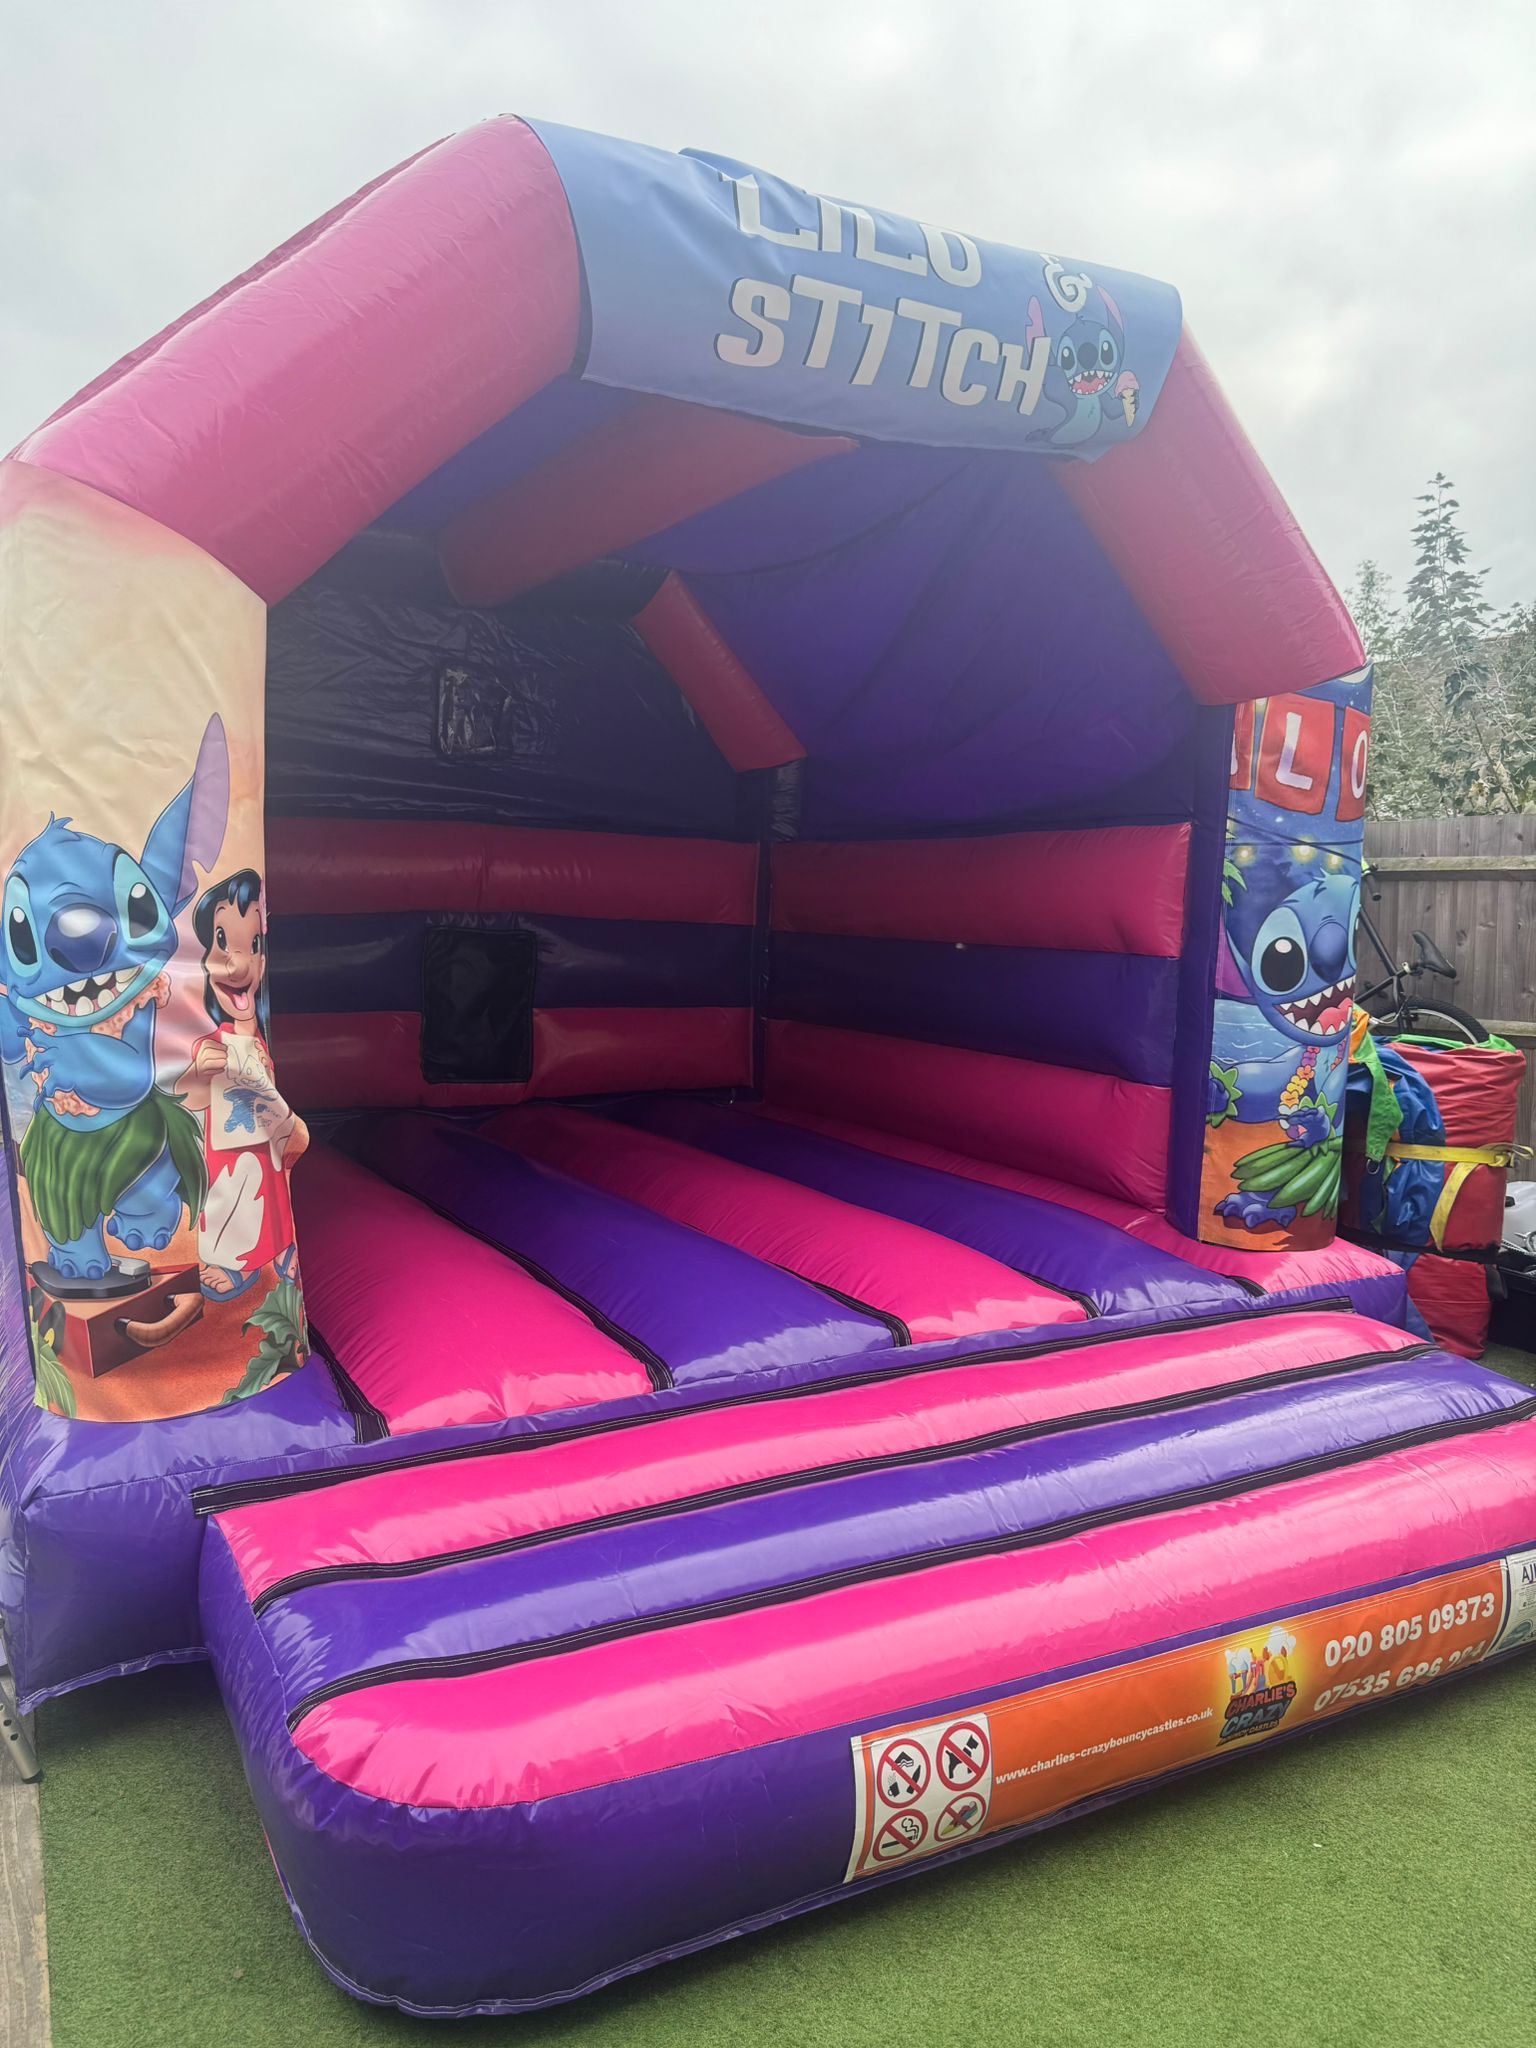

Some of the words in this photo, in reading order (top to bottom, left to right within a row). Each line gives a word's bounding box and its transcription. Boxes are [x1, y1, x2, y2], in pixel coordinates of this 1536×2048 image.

[719, 172, 982, 288] LILO
[714, 274, 1052, 416] STITCH
[1325, 1630, 1373, 1667] 020
[1379, 1615, 1423, 1651] 805
[1428, 1592, 1495, 1635] 09373
[1221, 1700, 1291, 1738] CRAZY
[1226, 1682, 1296, 1718] CHARLIE'S
[1313, 1670, 1391, 1712] 07535
[995, 1707, 1214, 1785] www.charlies-crazybouncycastles.co.uk
